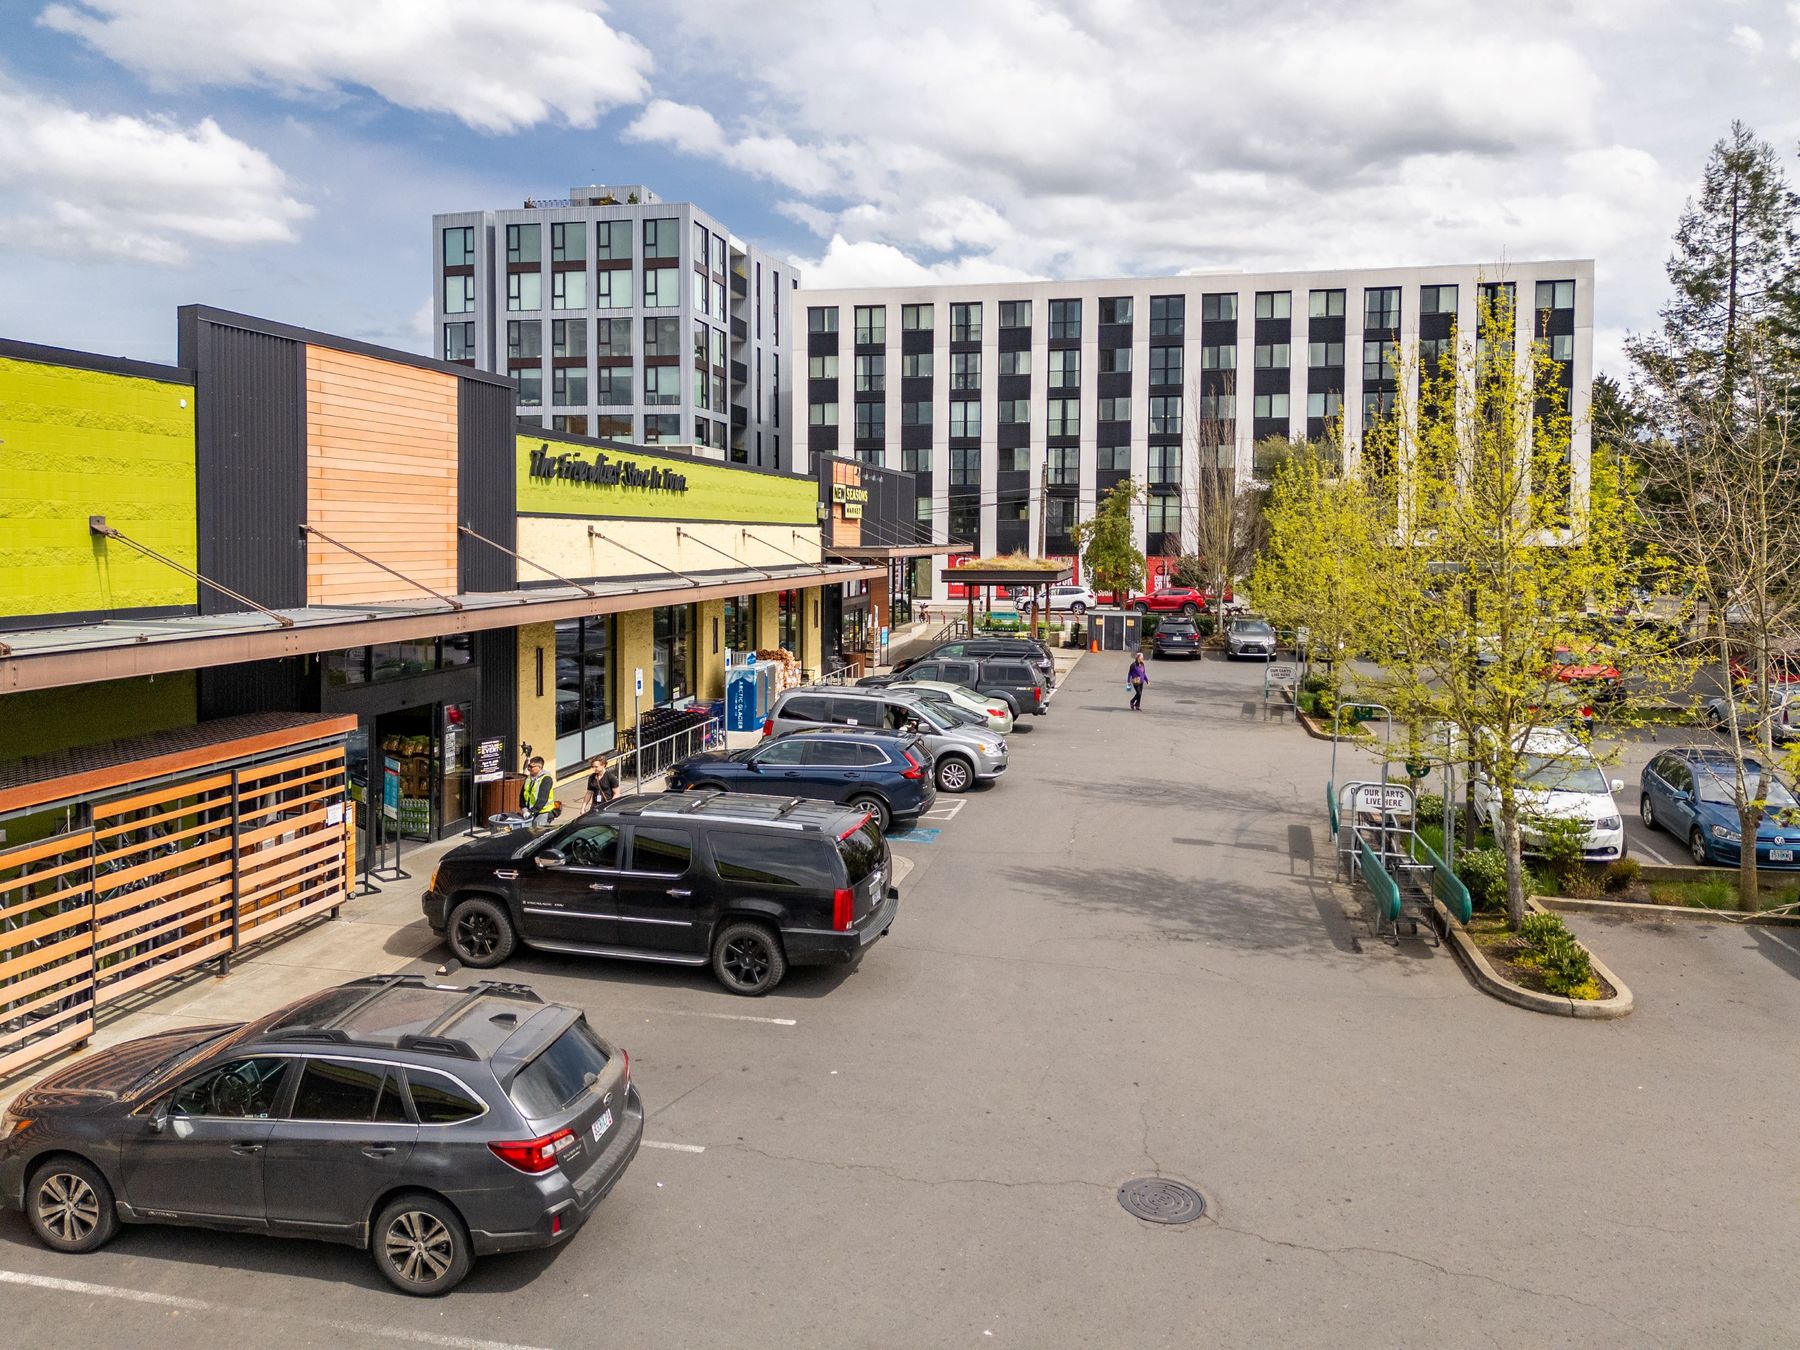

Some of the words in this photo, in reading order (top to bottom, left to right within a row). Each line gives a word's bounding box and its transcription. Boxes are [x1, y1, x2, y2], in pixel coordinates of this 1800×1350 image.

[529, 443, 556, 478] The
[834, 487, 844, 500] NEW
[846, 488, 868, 502] SEASONS
[1364, 788, 1379, 796] OUR
[1383, 790, 1404, 798] ARTS
